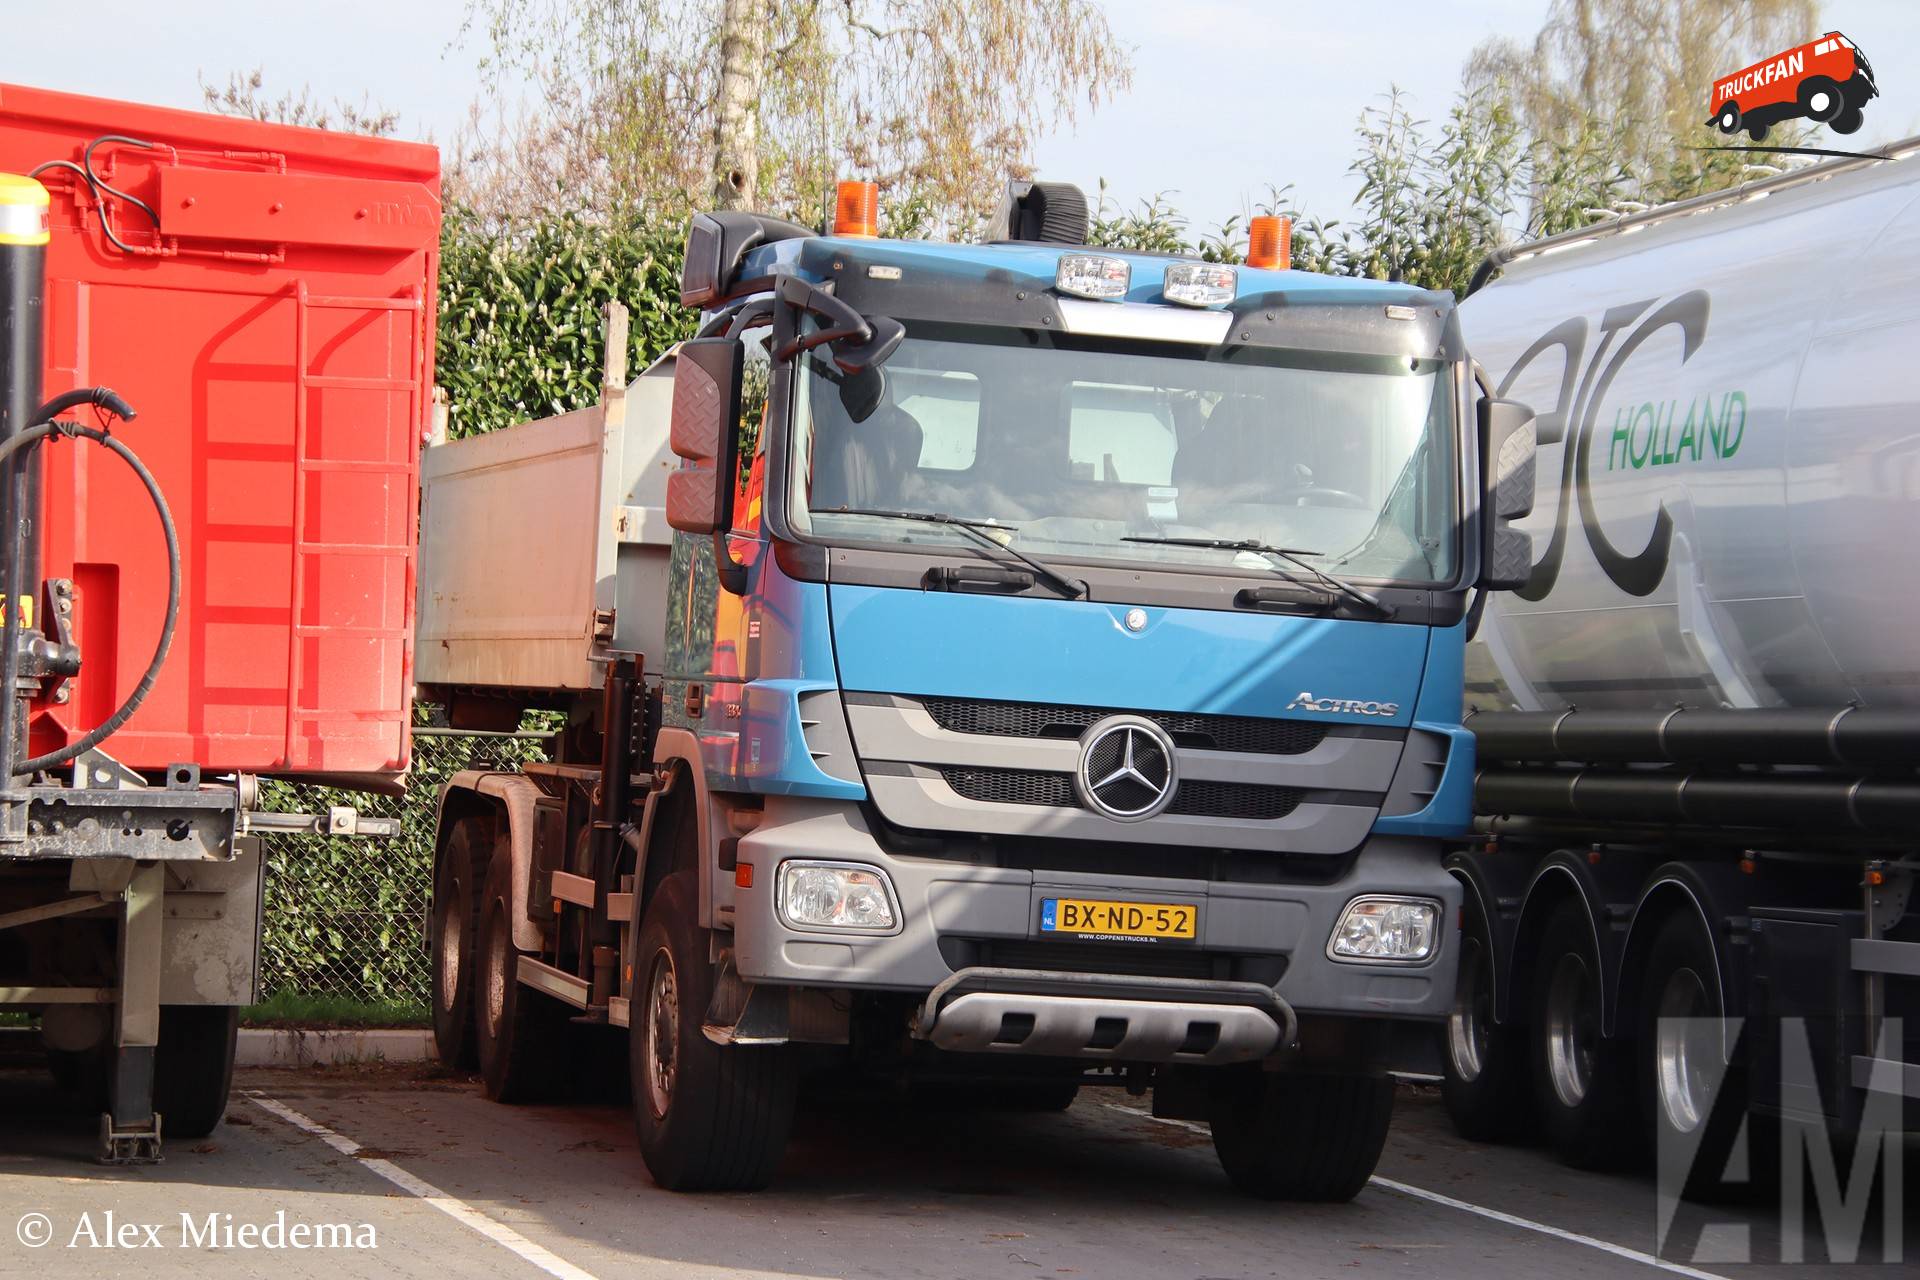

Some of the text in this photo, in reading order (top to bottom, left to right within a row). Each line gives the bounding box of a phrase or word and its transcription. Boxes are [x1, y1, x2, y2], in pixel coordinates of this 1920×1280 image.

[1608, 391, 1747, 471] HOLLAND
[1043, 917, 1055, 925] NL
[1063, 904, 1188, 932] BX-ND-52
[1078, 933, 1158, 942] WWW.COPPENSTRUCKS.NL
